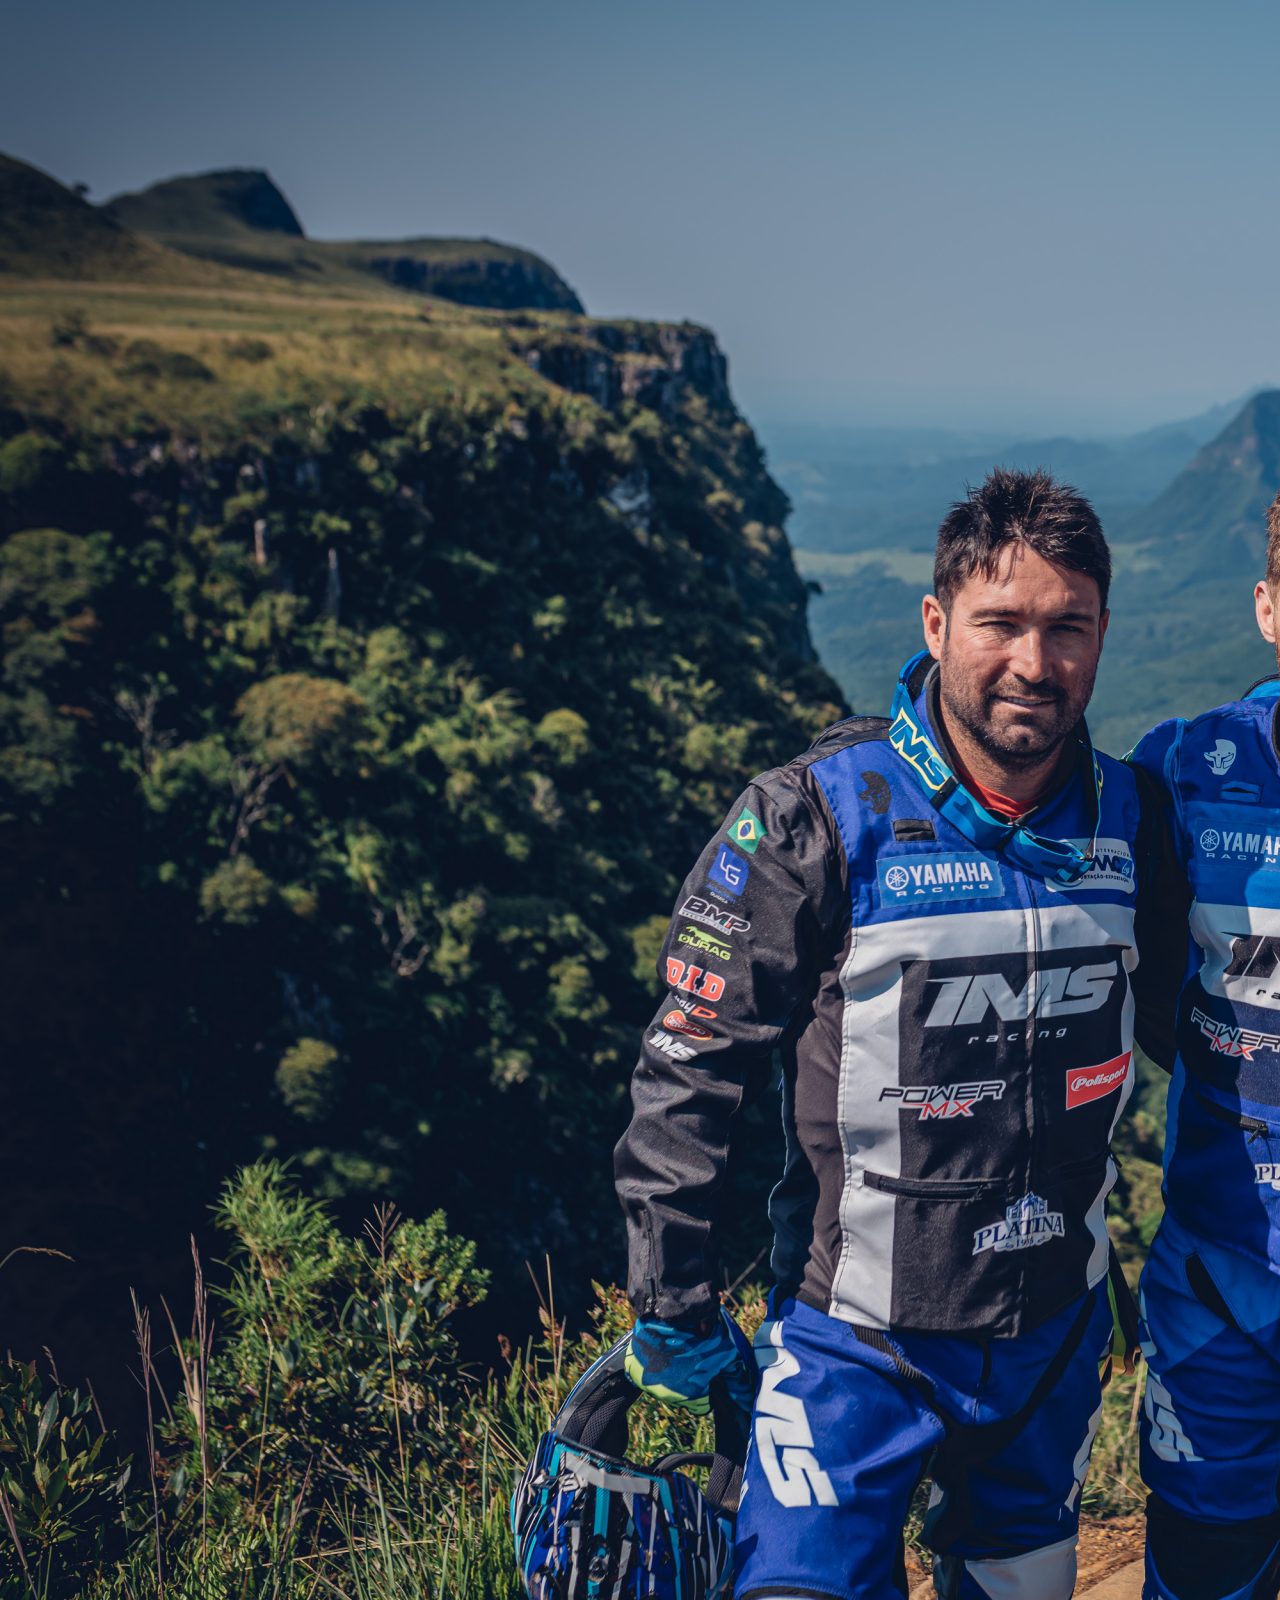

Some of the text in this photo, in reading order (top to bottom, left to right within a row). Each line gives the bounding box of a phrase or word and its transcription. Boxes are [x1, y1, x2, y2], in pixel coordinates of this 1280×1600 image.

[889, 707, 949, 791] IMS
[909, 862, 993, 886] YAMAHA
[896, 883, 990, 898] RACING
[678, 895, 751, 935] BMP
[678, 933, 731, 961] DURAG
[924, 960, 1118, 1028] IMS
[648, 1027, 698, 1061] IMS
[967, 1027, 1067, 1045] racing
[1209, 1035, 1254, 1061] MX
[879, 1079, 1006, 1103] POWER
[1071, 1064, 1126, 1092] Polisport
[918, 1098, 975, 1121] MX
[974, 1214, 1063, 1252] PLATINA
